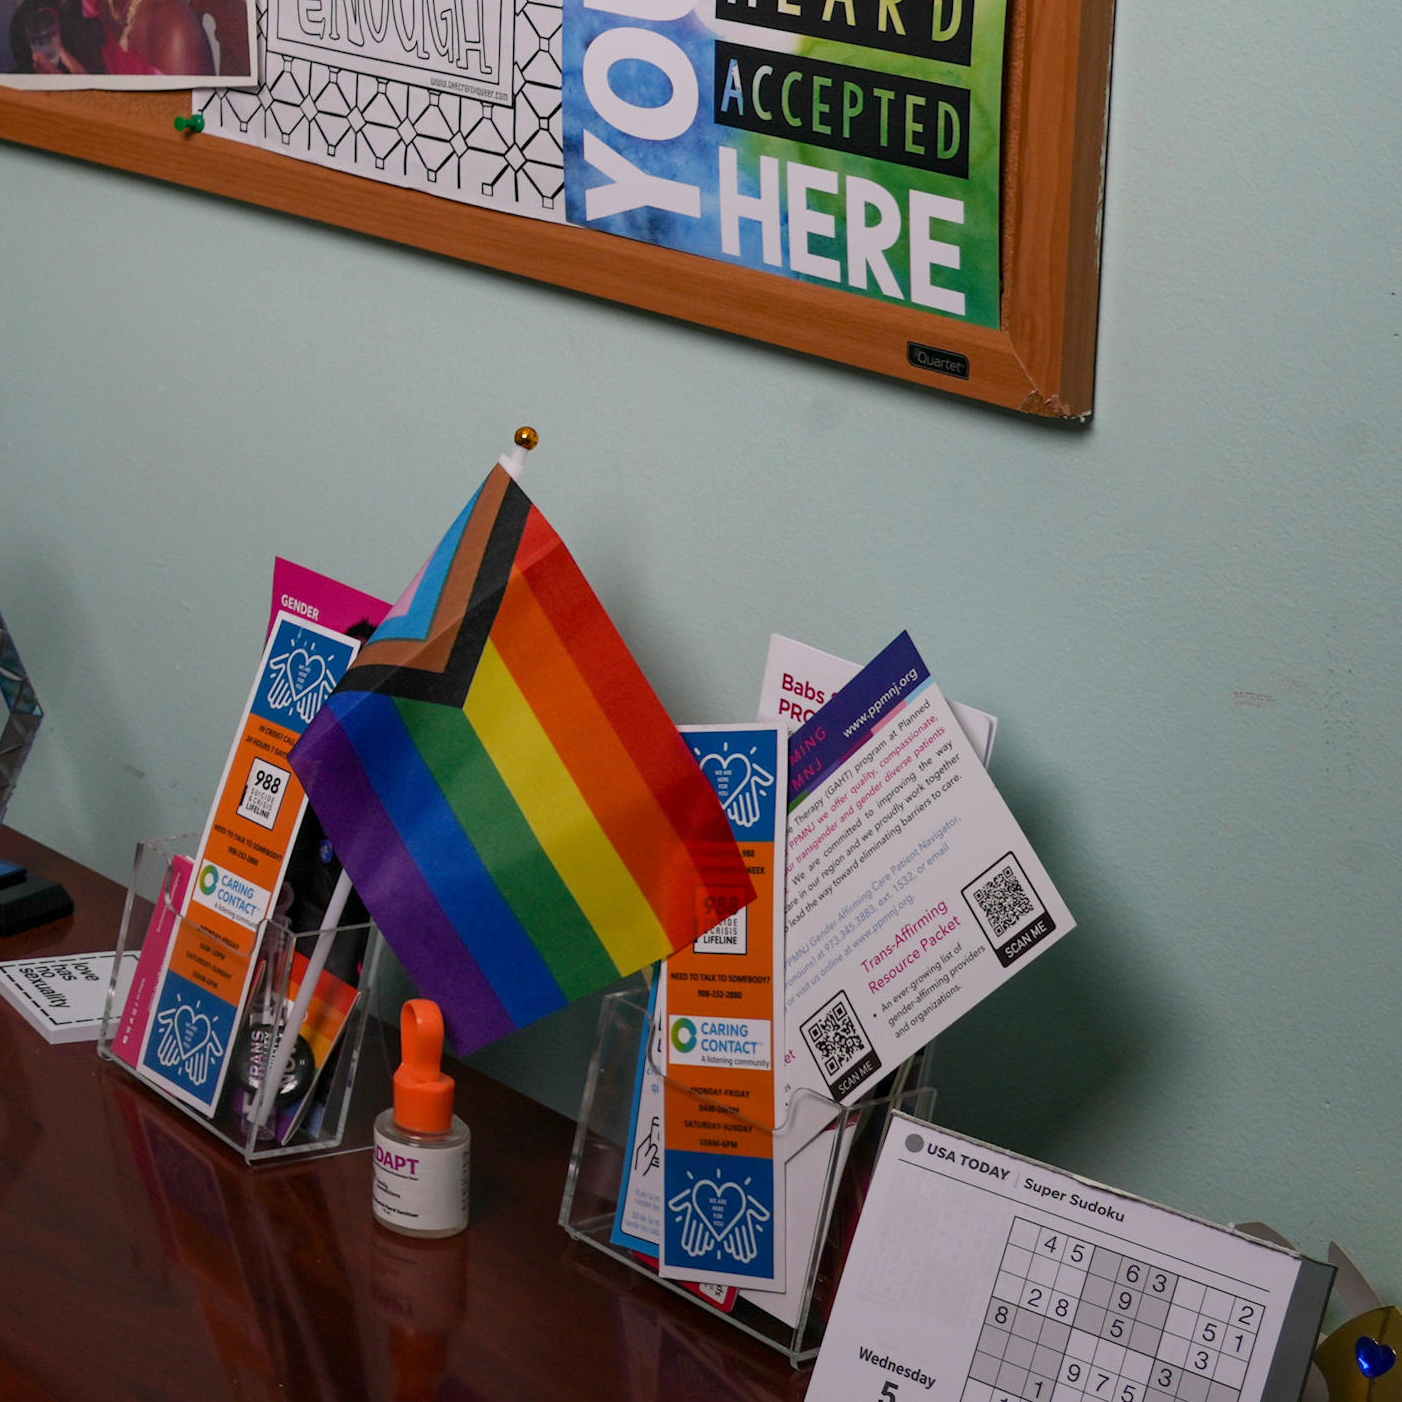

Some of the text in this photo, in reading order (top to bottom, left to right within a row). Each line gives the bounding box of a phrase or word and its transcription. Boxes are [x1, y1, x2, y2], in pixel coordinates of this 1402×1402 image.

[719, 57, 963, 162] ACCEPTED
[718, 145, 967, 317] HERE
[917, 351, 964, 373] Quartet
[281, 593, 320, 621] GENDER
[842, 668, 918, 739] www.ppmnj.org
[254, 769, 281, 794] 988
[704, 935, 738, 945] LIFELINE
[860, 899, 949, 973] Trans-Affirming
[1004, 920, 1048, 959] SCAN ME
[867, 915, 961, 994] Resource Packet
[38, 965, 56, 978] no
[55, 963, 77, 982] has
[72, 961, 100, 982] love
[671, 972, 770, 984] NEED TO TALK TO SOMEBODY?
[19, 968, 71, 1010] sexuality
[701, 1022, 749, 1037] CARING
[701, 1039, 757, 1054] CONTACT
[707, 1057, 733, 1065] listening
[734, 1059, 769, 1068] community
[926, 1141, 1126, 1223] USA TODAY Super Sudoku
[858, 1345, 937, 1390] Wednesday
